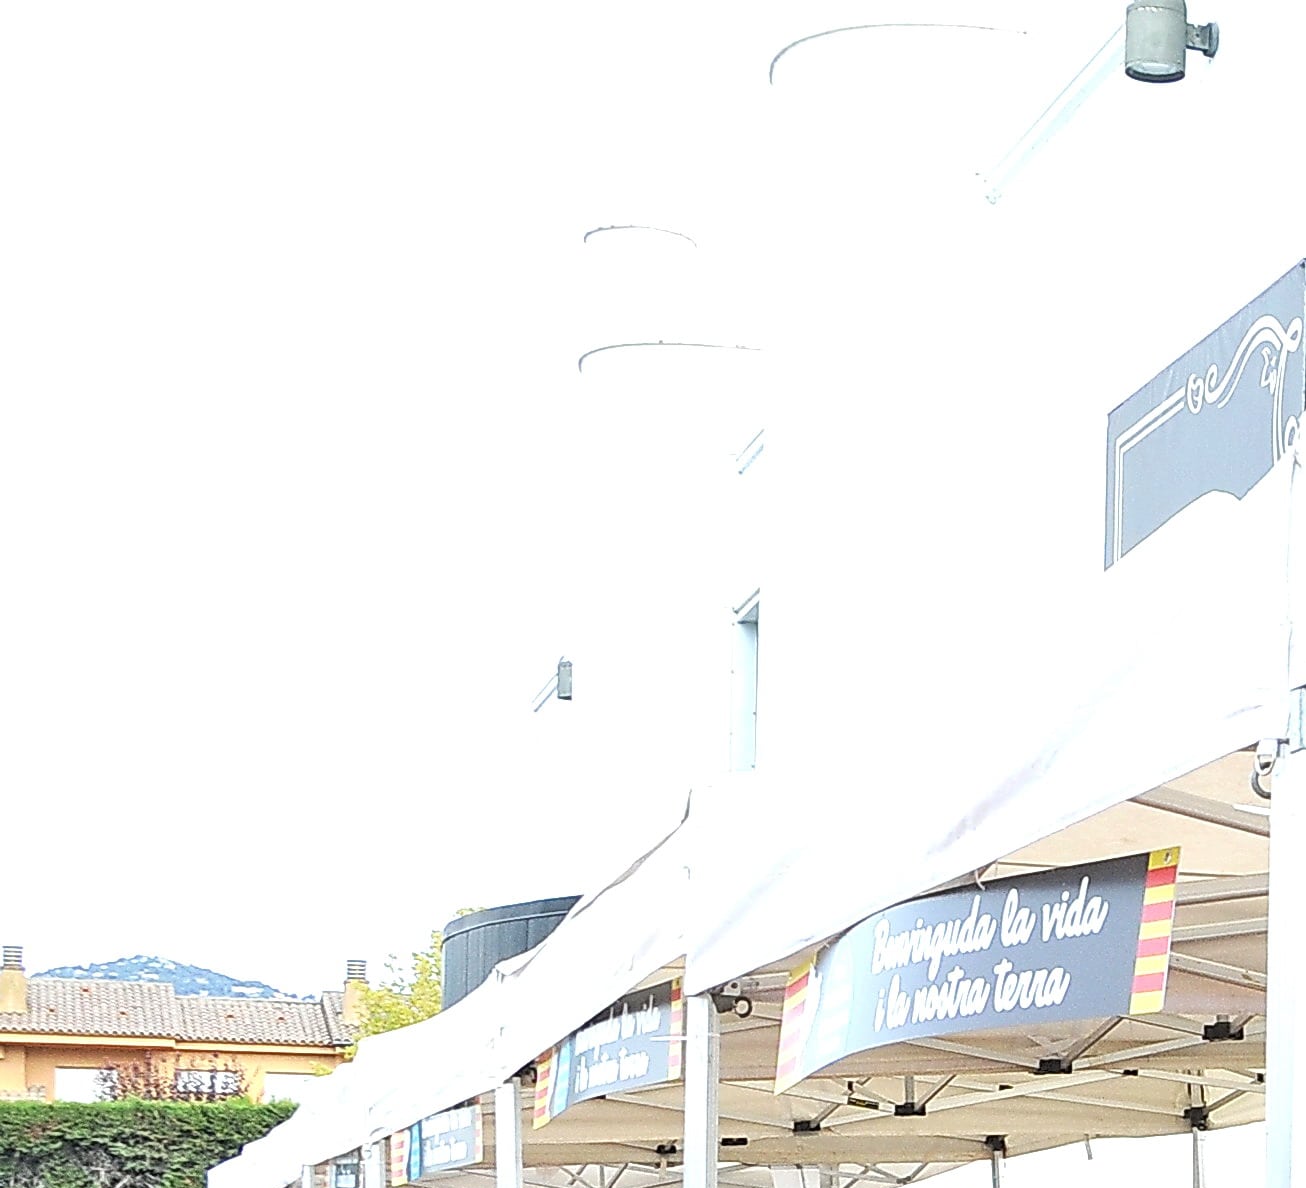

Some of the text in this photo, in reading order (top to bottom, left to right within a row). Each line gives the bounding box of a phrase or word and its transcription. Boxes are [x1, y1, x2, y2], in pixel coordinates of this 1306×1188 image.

[872, 875, 1109, 982] Benvinguda la vida
[886, 974, 911, 1029] la
[911, 965, 991, 1024] nostra
[993, 958, 1071, 1013] terra
